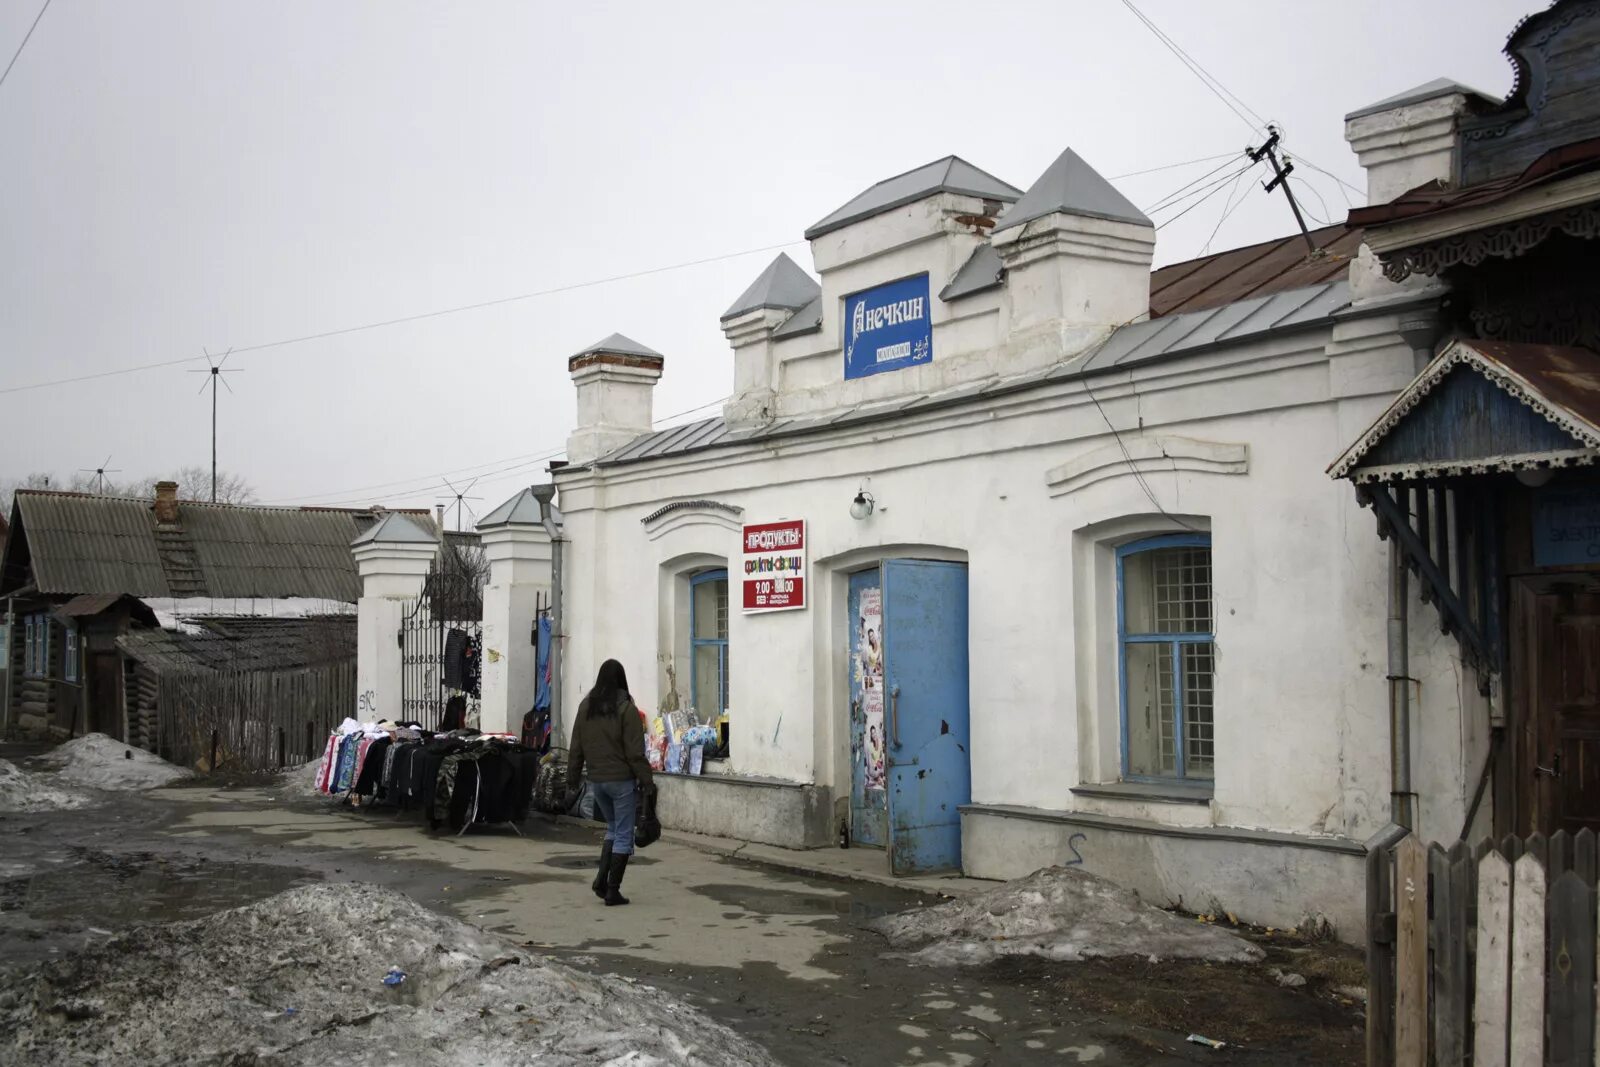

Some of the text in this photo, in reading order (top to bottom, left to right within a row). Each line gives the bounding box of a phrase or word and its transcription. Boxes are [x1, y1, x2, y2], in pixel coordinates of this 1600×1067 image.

[850, 296, 924, 342] Анечкин
[748, 528, 799, 549] ПРОДУКТЫ
[756, 581, 770, 594] 9.00
